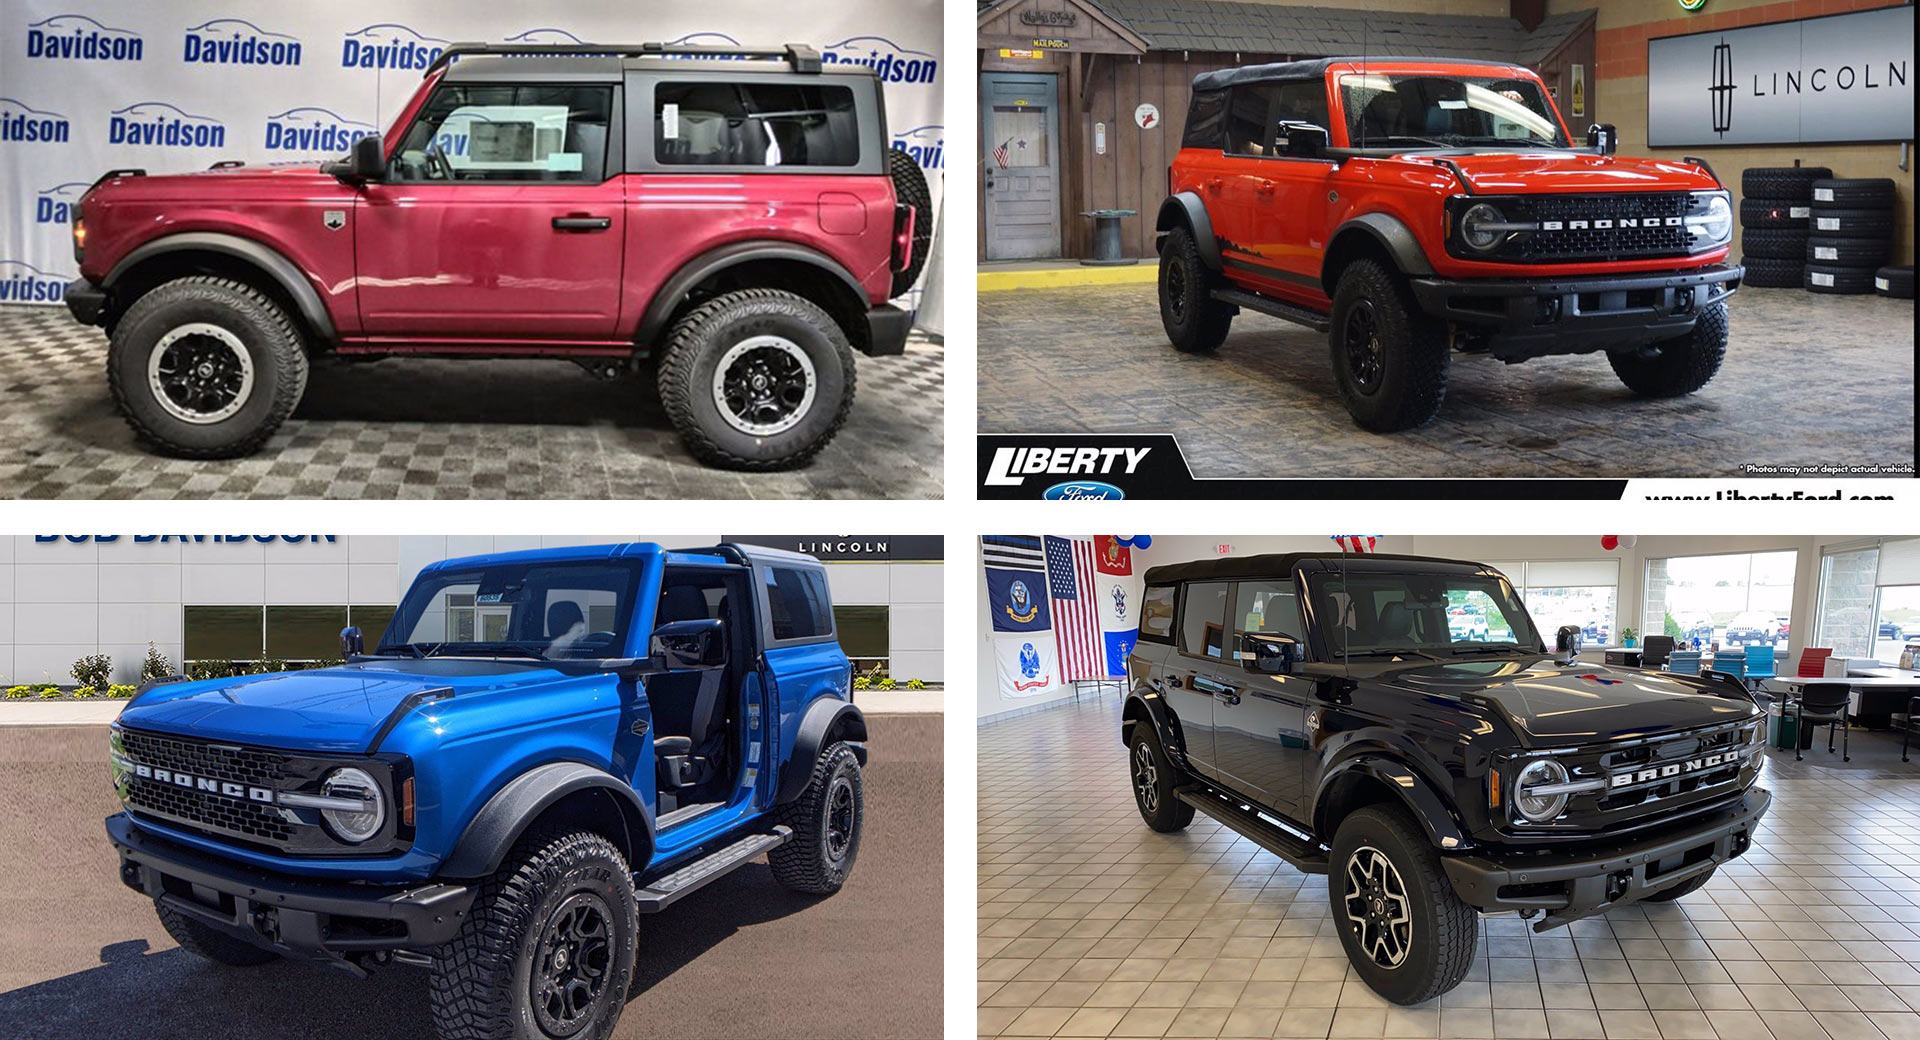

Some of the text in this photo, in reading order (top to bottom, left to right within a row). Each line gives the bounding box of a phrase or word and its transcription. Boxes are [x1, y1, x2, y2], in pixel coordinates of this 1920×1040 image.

[27, 28, 143, 61] Davidson
[184, 33, 302, 66] Davidson
[342, 37, 458, 70] Davids
[1754, 60, 1906, 96] LINCOLN
[0, 111, 69, 142] idson
[110, 115, 226, 148] Davidson
[265, 120, 380, 152] Davids
[1543, 216, 1682, 231] BRONCO
[799, 542, 887, 552] LINCOLN
[136, 764, 273, 803] BRONCO
[1611, 750, 1739, 787] BRONCO
